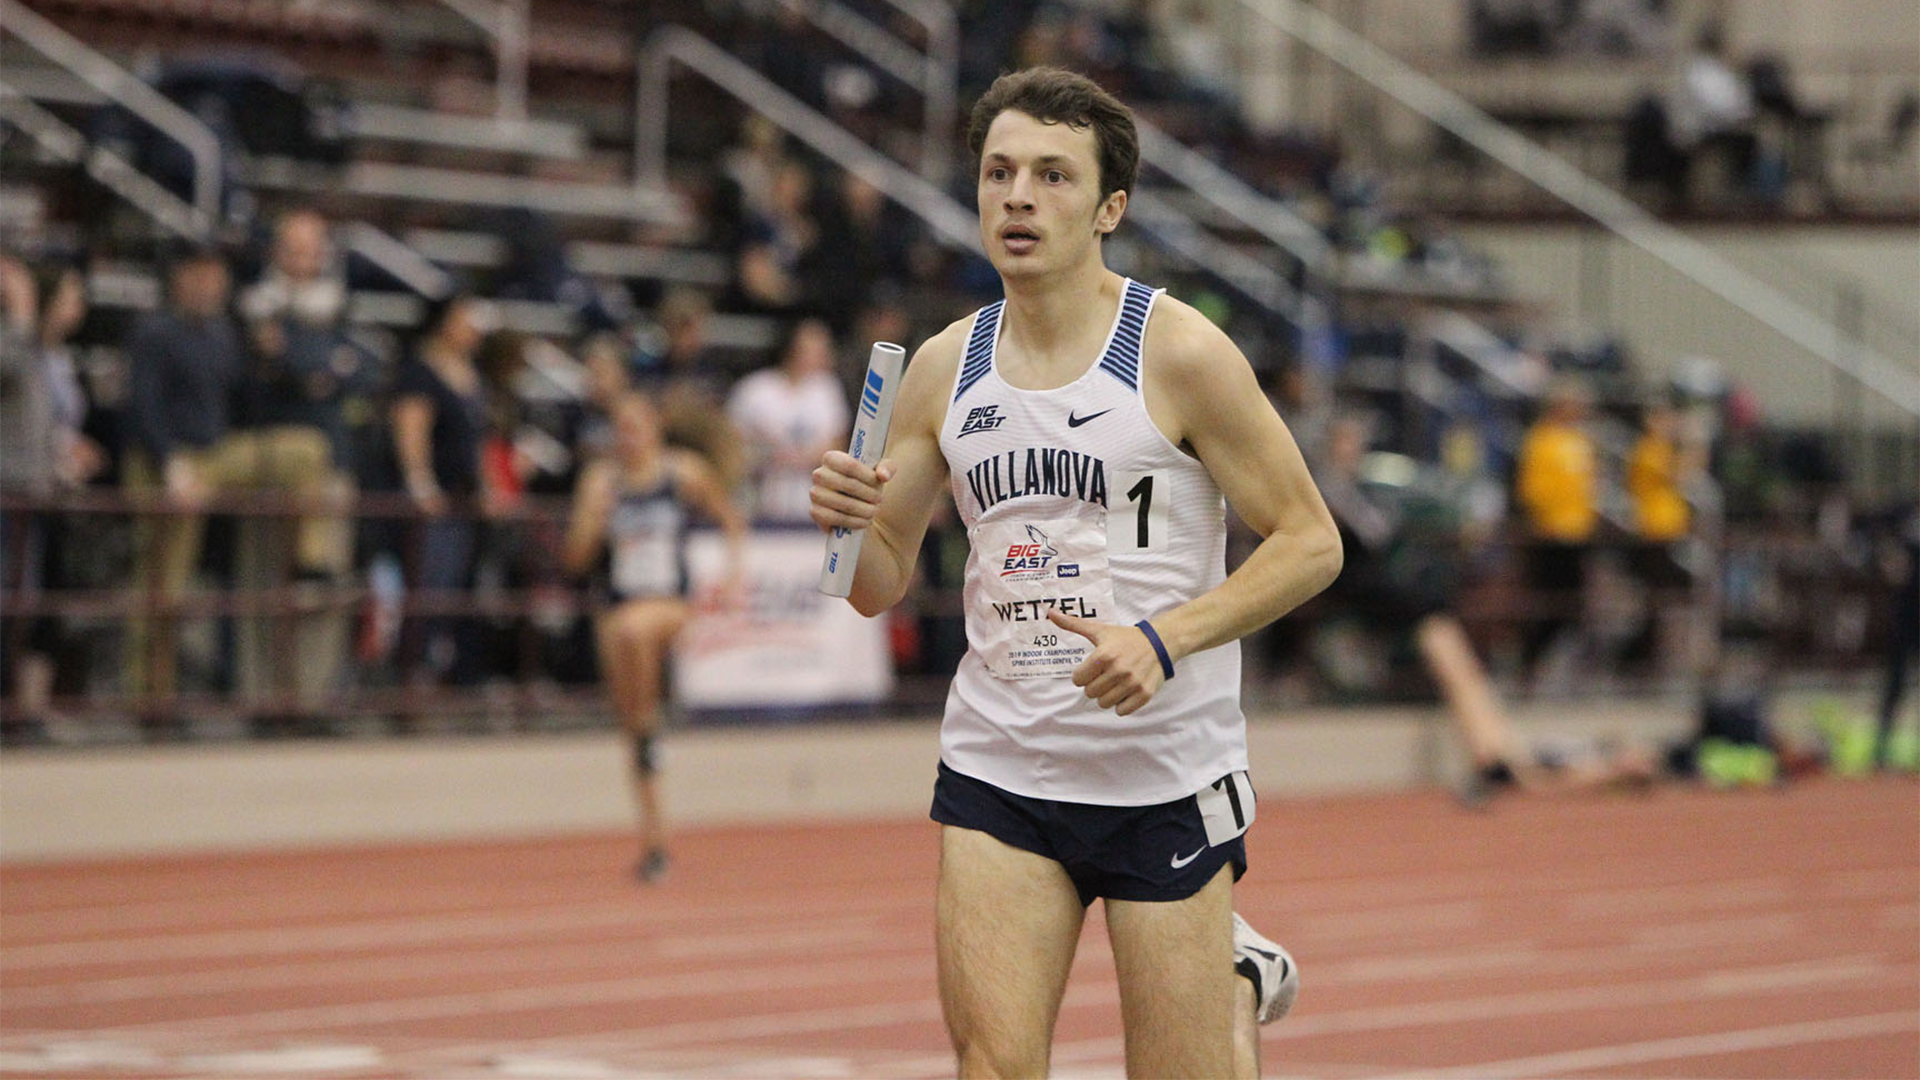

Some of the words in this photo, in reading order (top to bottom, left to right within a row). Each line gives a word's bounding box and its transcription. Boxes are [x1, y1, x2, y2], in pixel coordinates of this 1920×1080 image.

[967, 404, 999, 420] BIG
[961, 416, 1006, 432] EAST
[966, 447, 1108, 513] VILLANOVA
[1127, 475, 1154, 548] 1
[1007, 544, 1041, 558] BIG
[1003, 556, 1052, 570] EAST
[1059, 567, 1077, 577] Jeep
[1033, 635, 1058, 647] 430
[1211, 773, 1245, 831] 1
